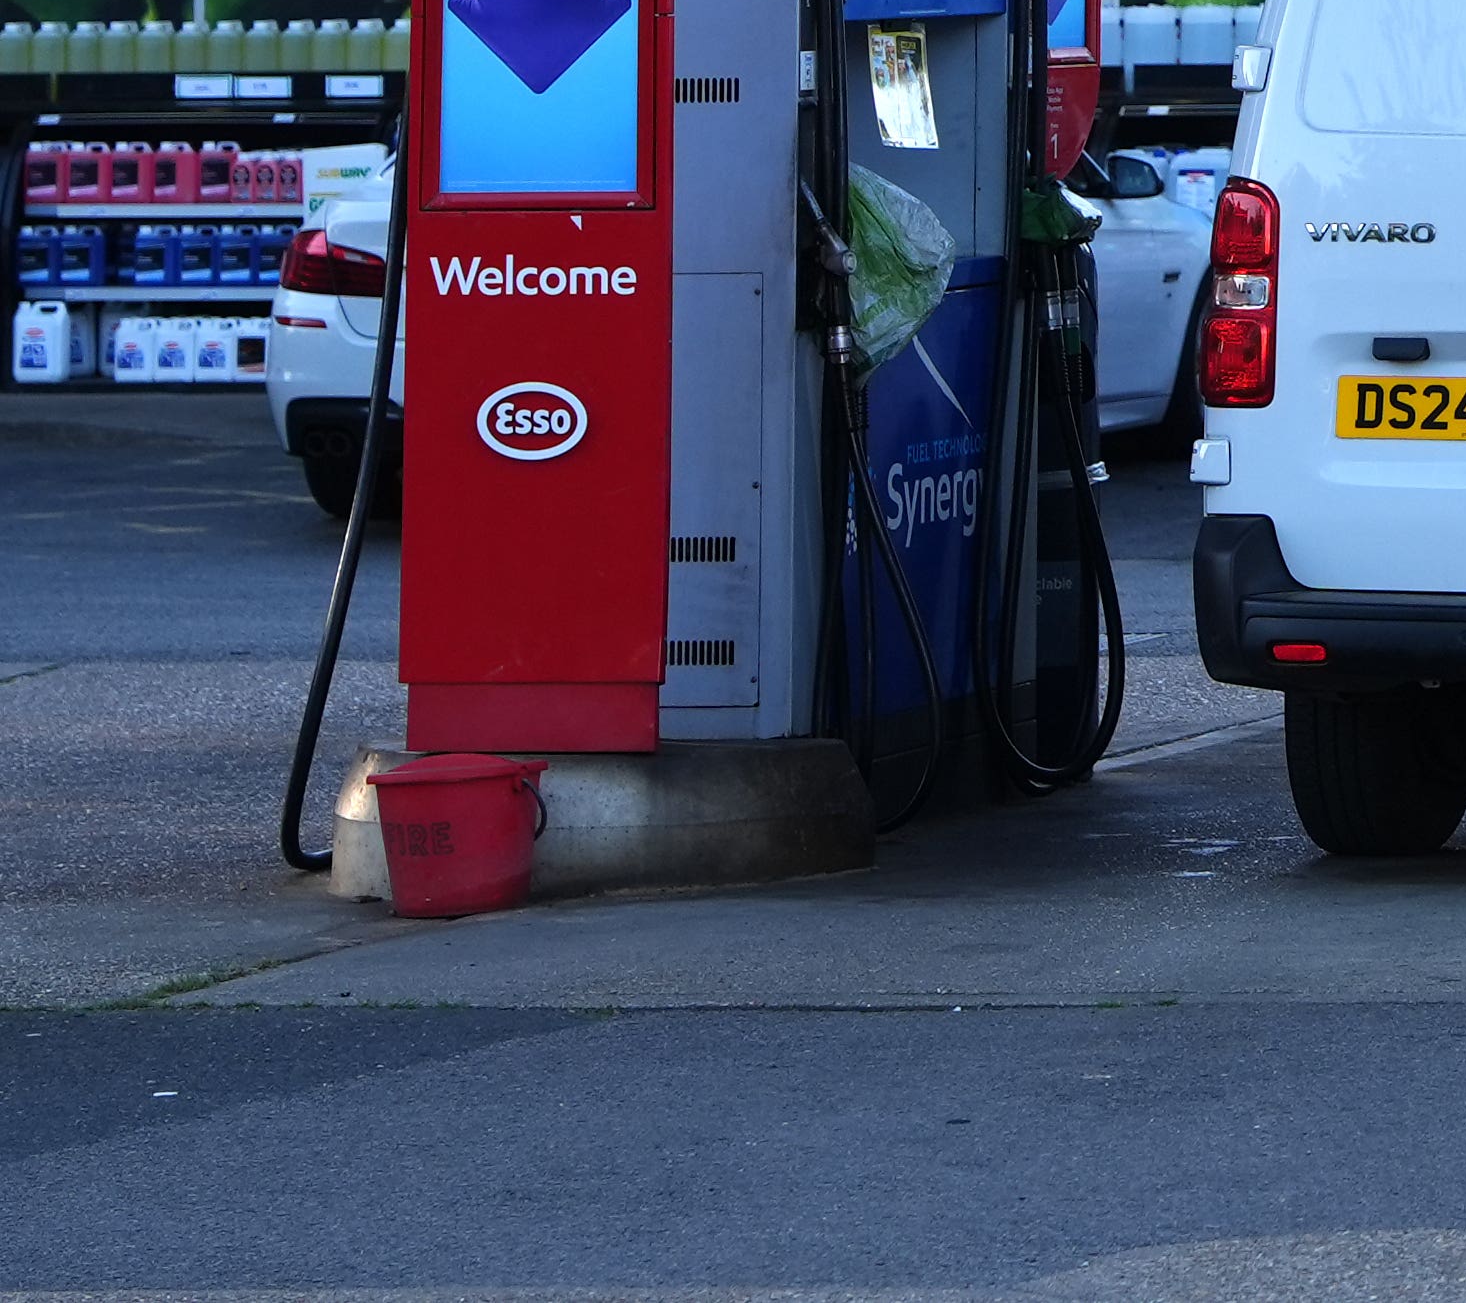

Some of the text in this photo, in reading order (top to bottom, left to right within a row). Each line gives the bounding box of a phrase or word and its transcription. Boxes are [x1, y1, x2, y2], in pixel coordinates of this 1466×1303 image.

[1305, 222, 1437, 244] VIVARO
[430, 255, 637, 296] Welcome
[907, 433, 987, 465] FUEL TECHNOLO
